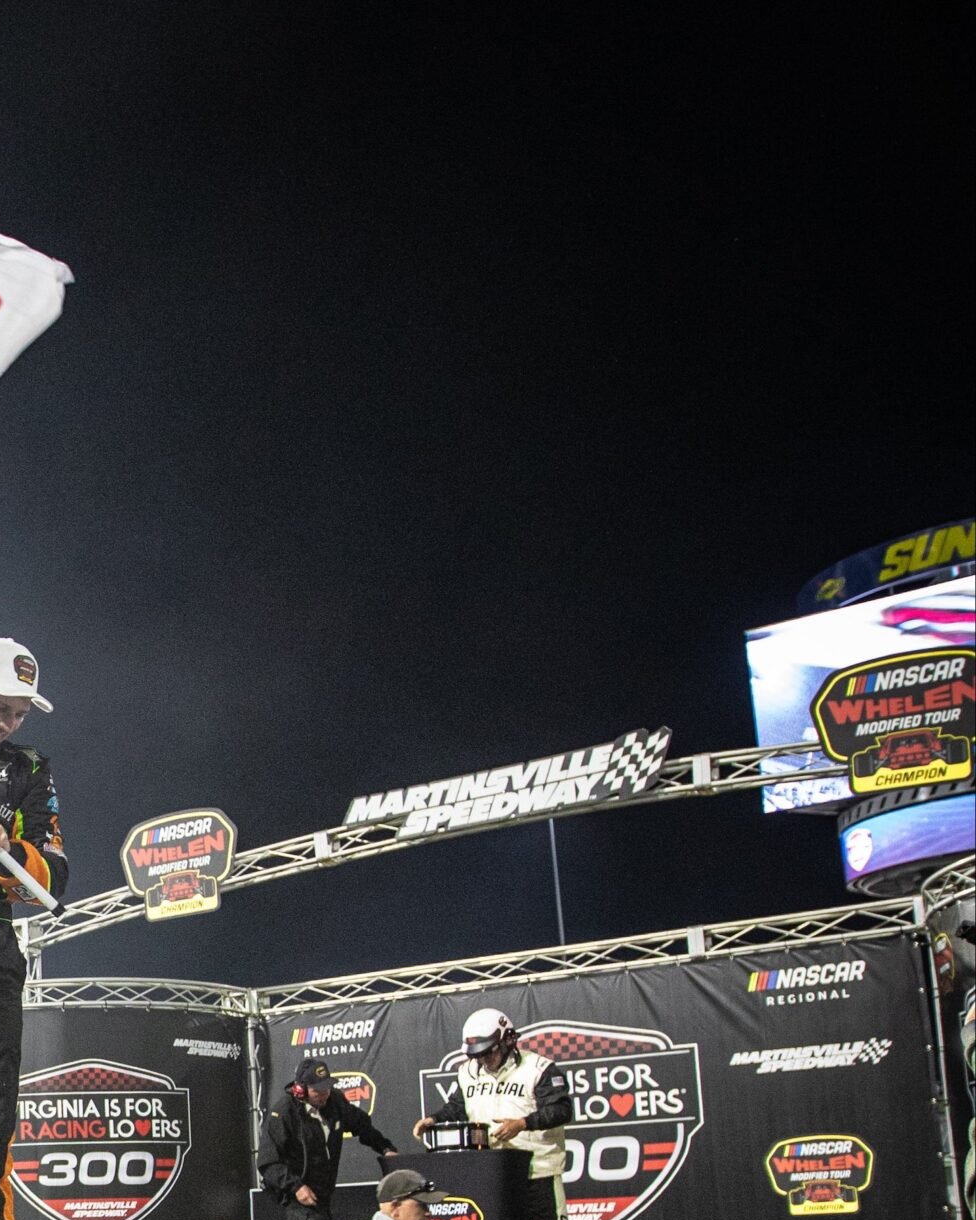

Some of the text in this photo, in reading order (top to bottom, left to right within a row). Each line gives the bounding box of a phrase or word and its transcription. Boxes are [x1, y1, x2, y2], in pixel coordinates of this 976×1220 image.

[875, 657, 966, 692] NASCAR
[827, 677, 976, 725] WHELEN
[856, 708, 962, 737] MODIFIED TOUR
[346, 745, 614, 824] MARTINSVILLE
[875, 766, 947, 787] CHAMPION
[398, 772, 606, 836] SPEEDWAY
[158, 817, 212, 843] NASCAR
[130, 829, 225, 868] WHELEN
[148, 855, 211, 876] MODIFIED TOUR
[776, 960, 866, 990] NASCAR
[766, 989, 850, 1006] REGIONAL
[311, 1019, 375, 1044] NASCAR
[173, 1038, 232, 1050] MARTINSVILLE
[187, 1047, 230, 1058] SPEEDWAY
[304, 1043, 363, 1058] REGIONAL
[729, 1040, 865, 1066] MARTINSVILLE
[756, 1053, 858, 1074] SPEEDWAY
[596, 1063, 660, 1093] FOR
[466, 1082, 526, 1099] OFFICIAL
[17, 1098, 167, 1120] IRGINIA IS FOR
[20, 1120, 106, 1141] RACING
[800, 1141, 853, 1156] NASCAR
[38, 1151, 154, 1187] 300
[772, 1151, 865, 1174] WHELEN
[790, 1170, 851, 1182] MODIFIED TOUR
[64, 1201, 138, 1211] MARTINSVILLE
[429, 1203, 470, 1216] NASCAR
